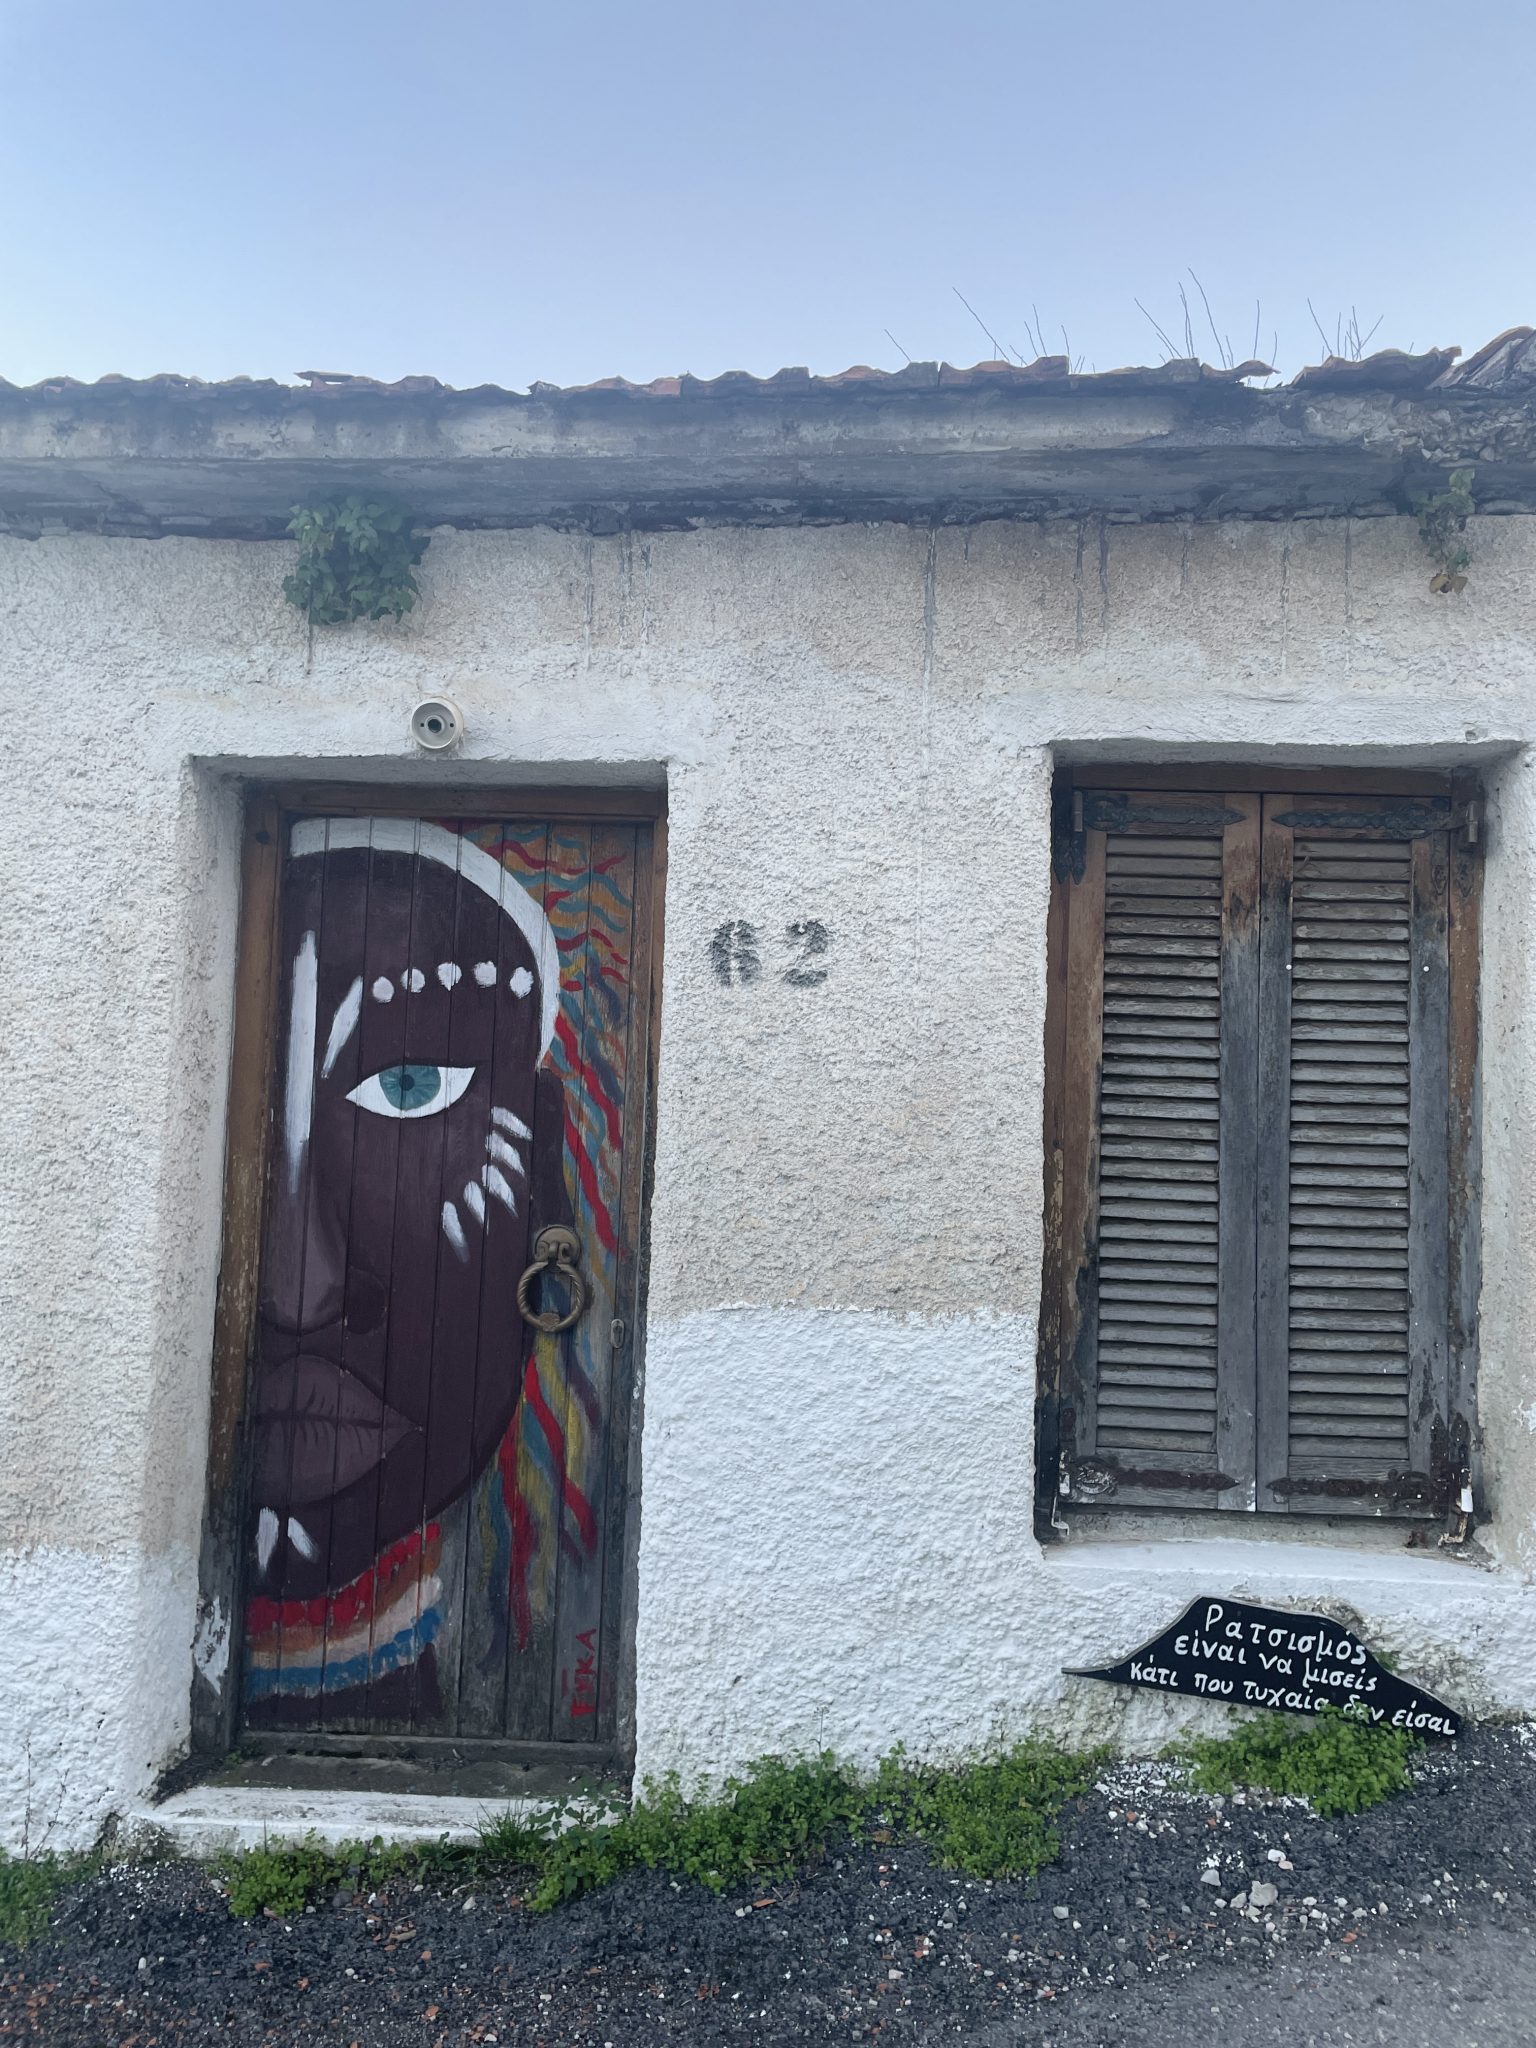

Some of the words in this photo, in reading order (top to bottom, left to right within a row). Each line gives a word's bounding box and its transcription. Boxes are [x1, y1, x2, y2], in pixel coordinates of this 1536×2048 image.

[1174, 1630, 1247, 1664] είναι
[1258, 1652, 1292, 1675] να
[1302, 1658, 1377, 1692] μισείς
[1206, 1604, 1367, 1664] Ρατσισμός
[1194, 1672, 1234, 1693] που
[1391, 1699, 1456, 1736] είσαι
